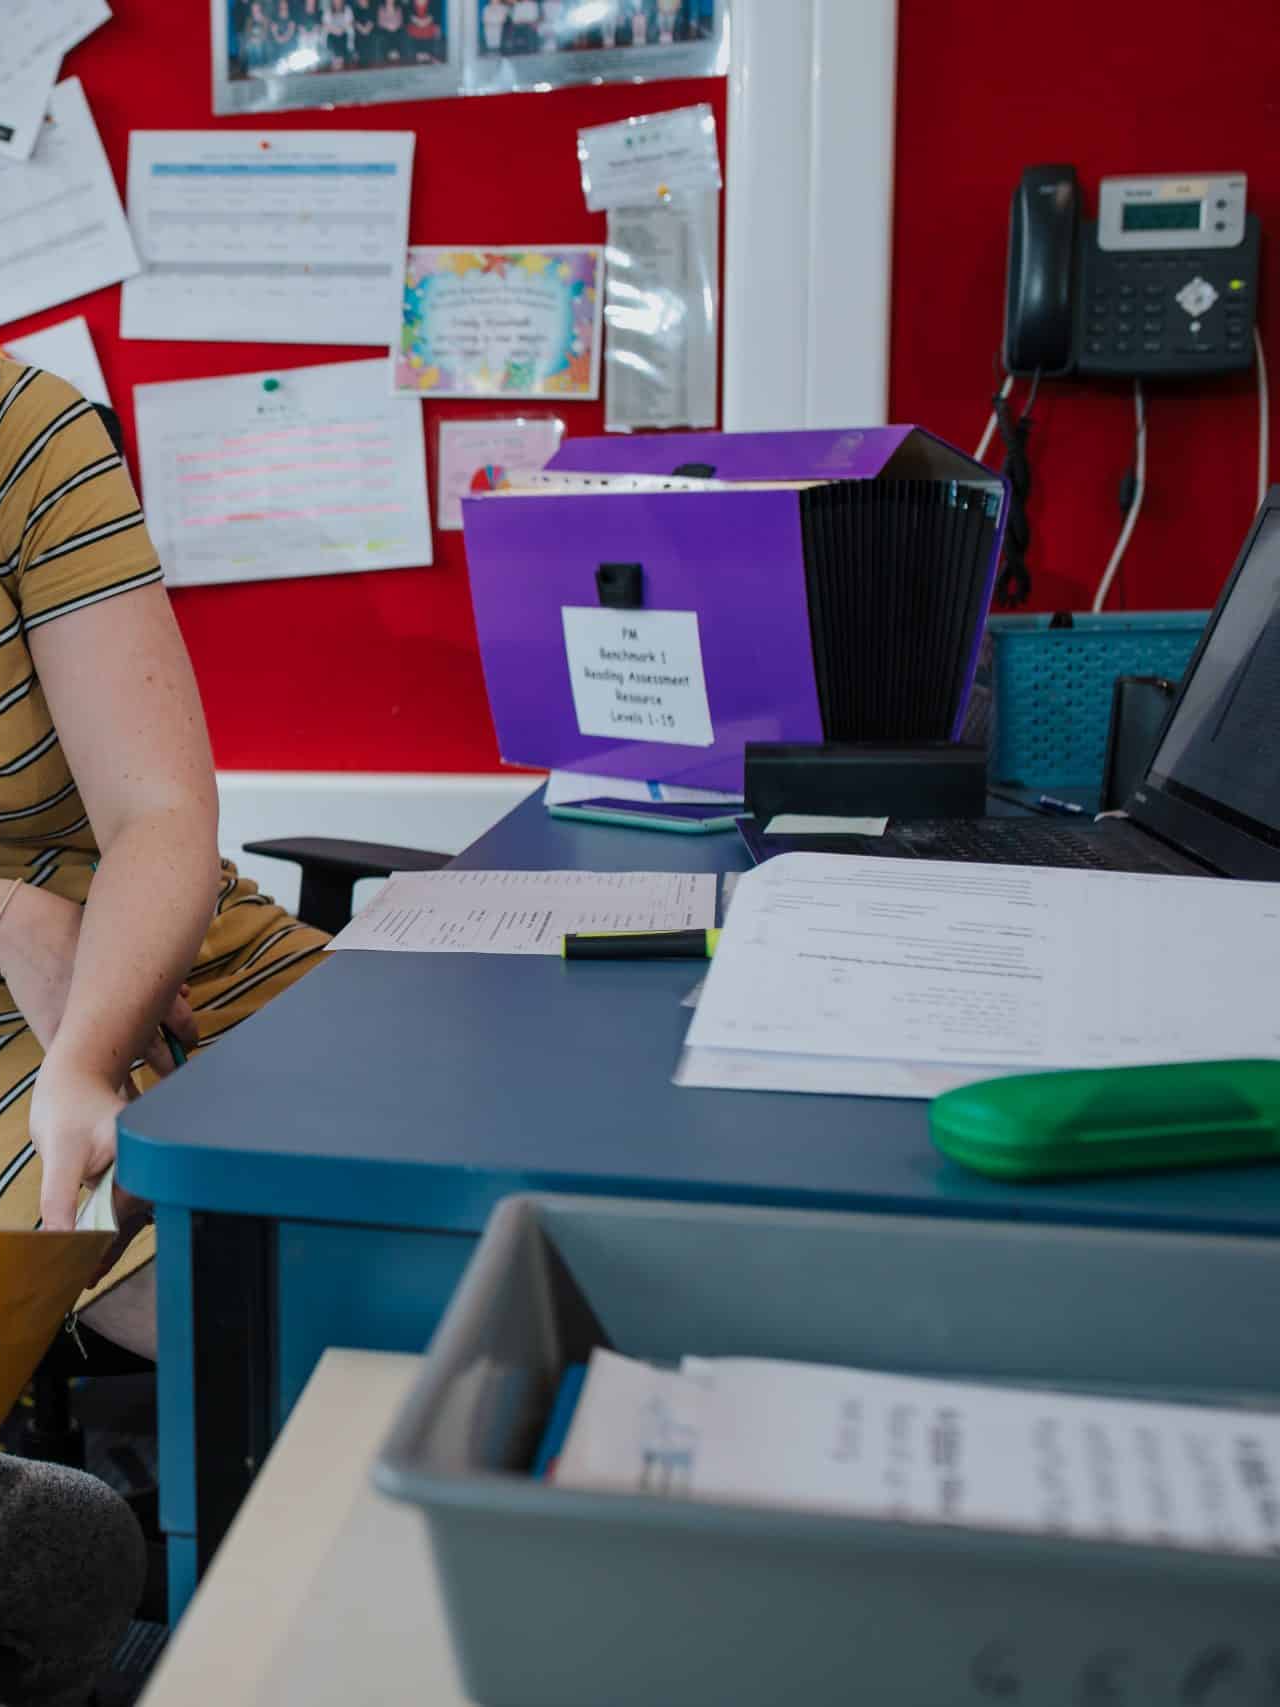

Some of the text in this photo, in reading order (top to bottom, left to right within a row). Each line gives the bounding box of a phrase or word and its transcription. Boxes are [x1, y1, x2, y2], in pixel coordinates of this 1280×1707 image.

[621, 627, 638, 641] PM
[599, 646, 656, 664] Benchmark
[583, 666, 690, 688] Reading Assessment
[615, 689, 662, 706] Resource
[610, 709, 643, 724] Levels
